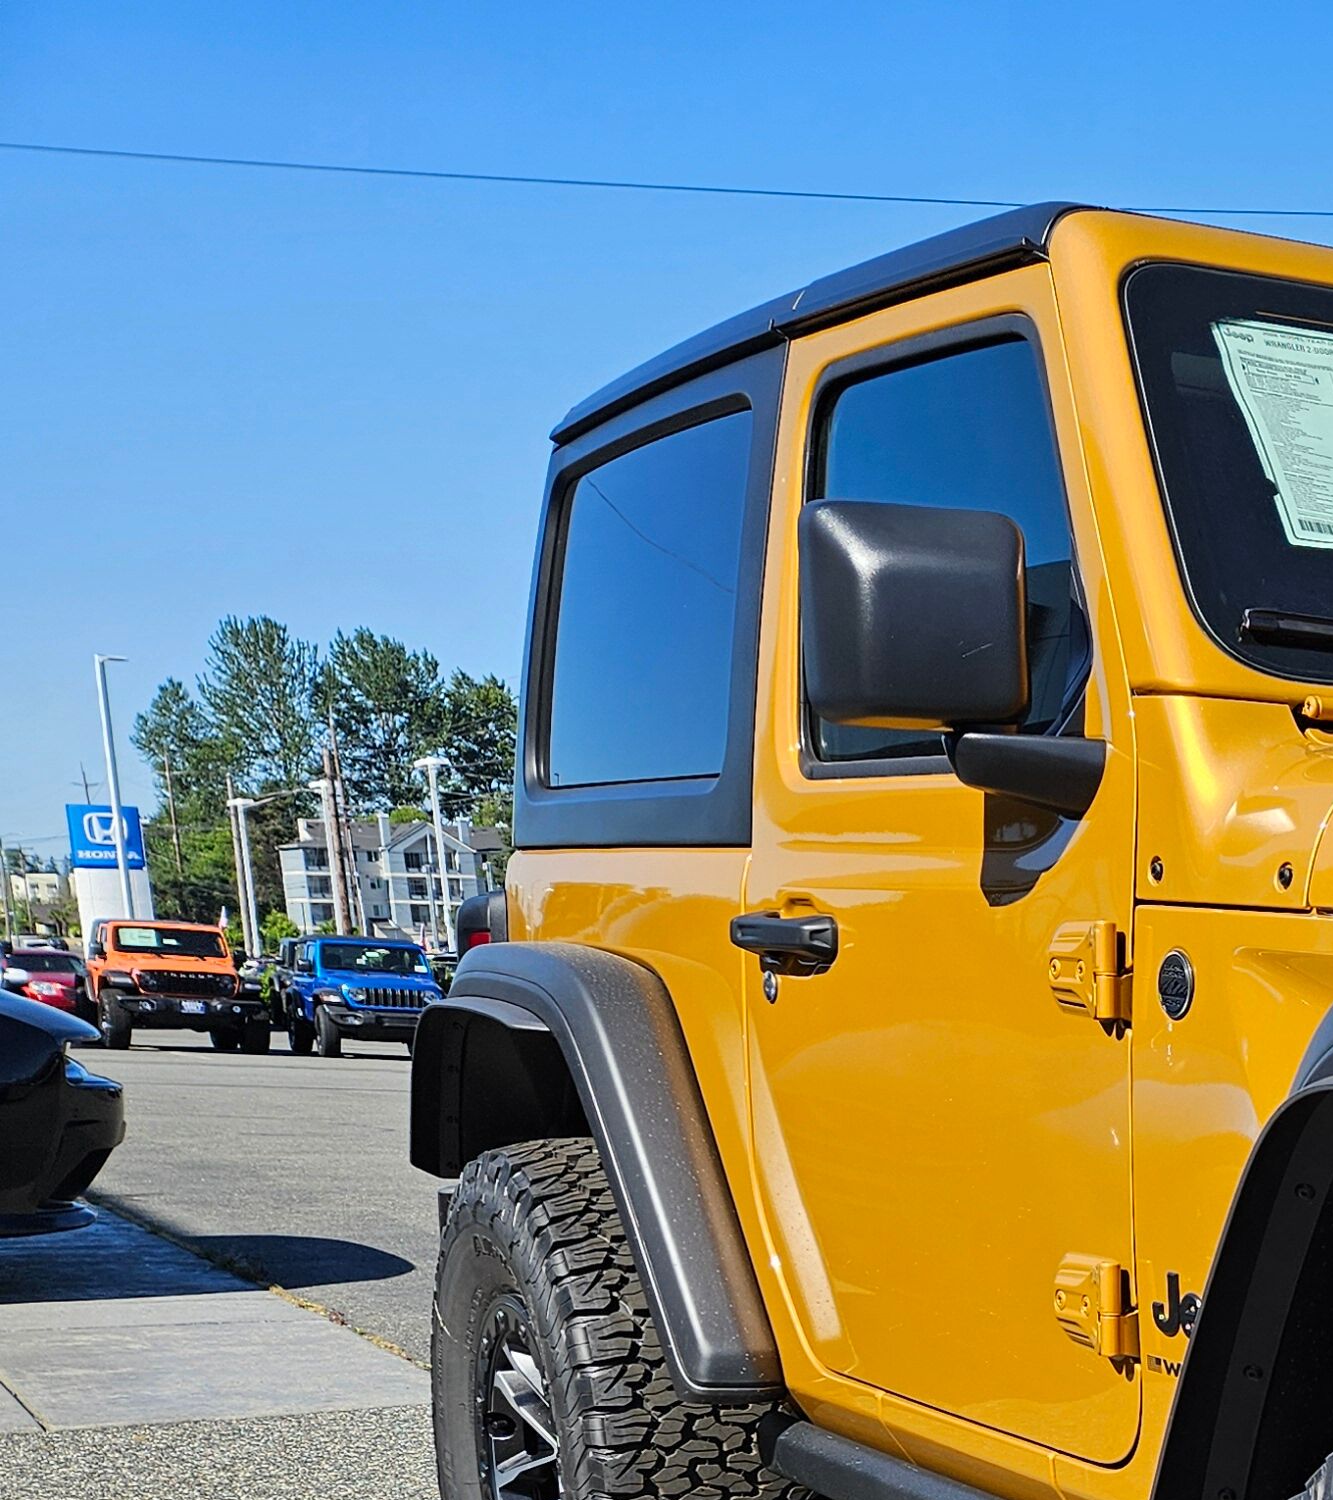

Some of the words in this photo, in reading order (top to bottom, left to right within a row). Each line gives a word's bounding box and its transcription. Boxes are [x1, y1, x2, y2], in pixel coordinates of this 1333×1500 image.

[1263, 339, 1306, 353] WRANGLER
[77, 849, 142, 861] HONA
[1152, 1271, 1203, 1339] Je
